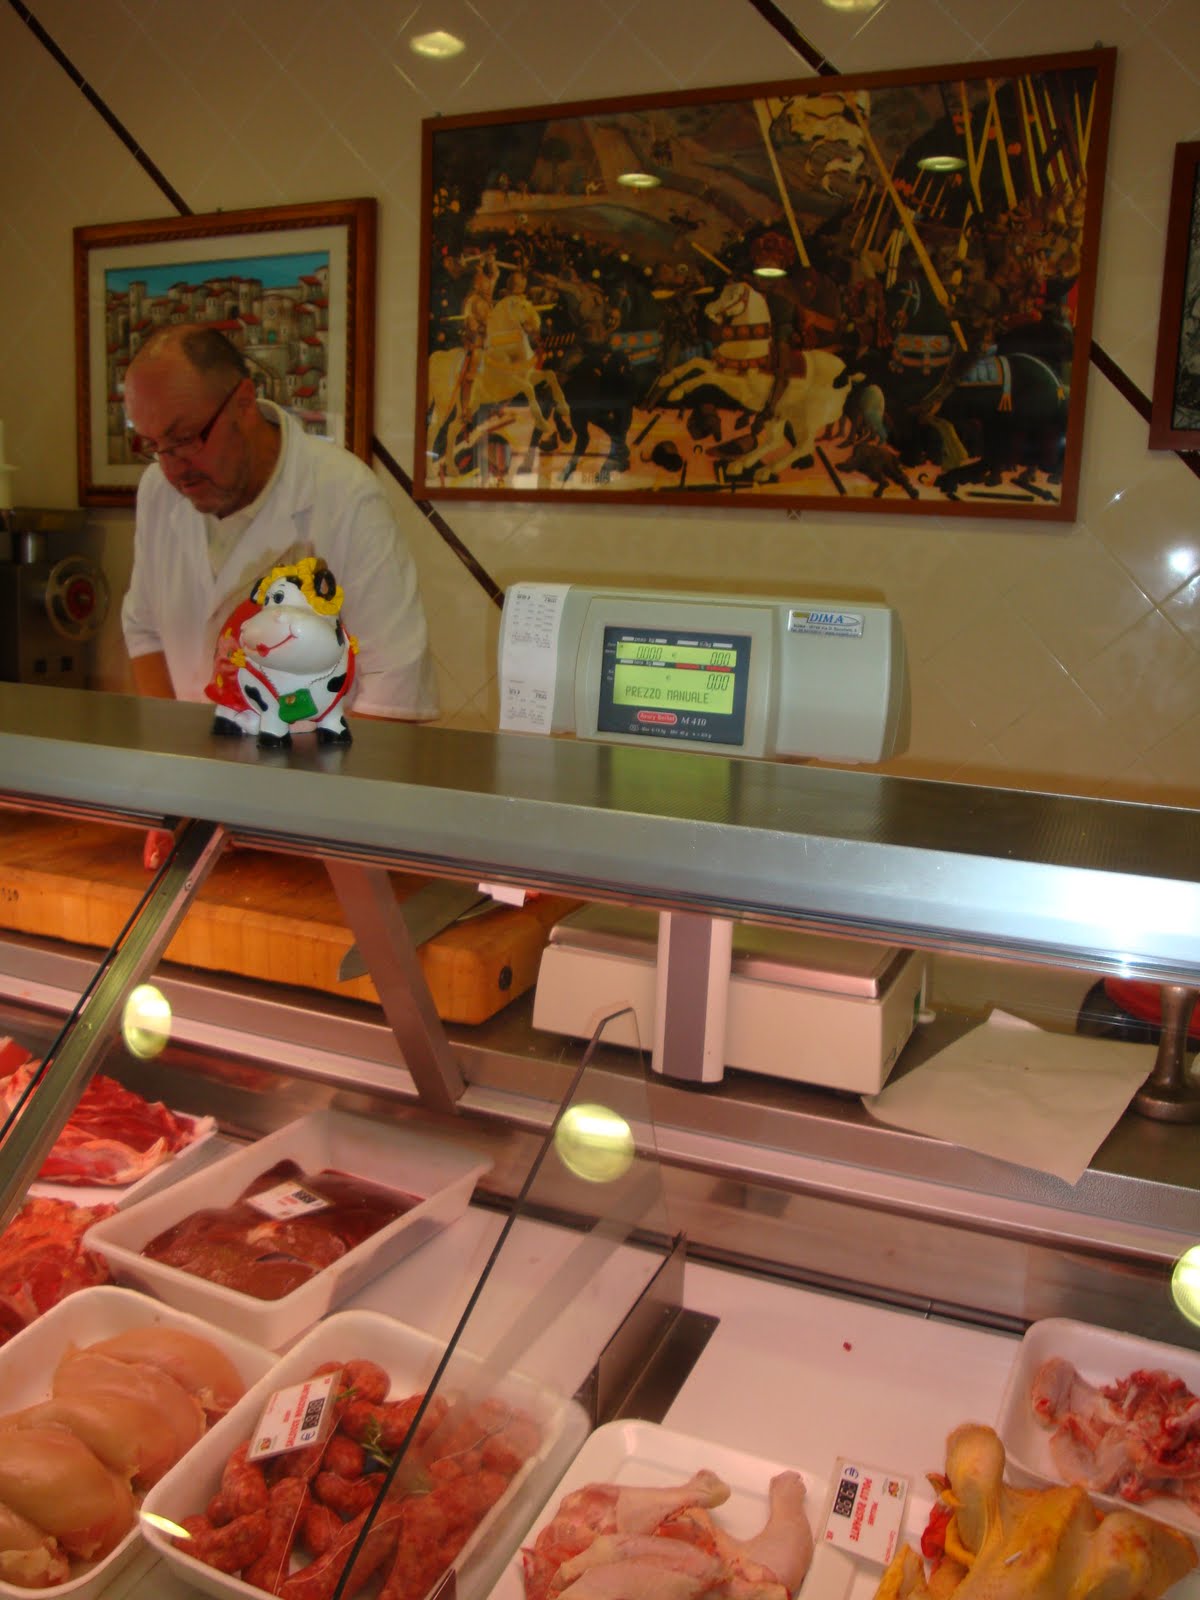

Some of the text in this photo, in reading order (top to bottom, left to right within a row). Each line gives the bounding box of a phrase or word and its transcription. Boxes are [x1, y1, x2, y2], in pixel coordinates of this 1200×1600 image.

[809, 612, 844, 624] DIMA
[625, 686, 709, 703] PREZZO MANUALE
[691, 718, 707, 726] 410
[860, 1478, 872, 1500] POLLO
